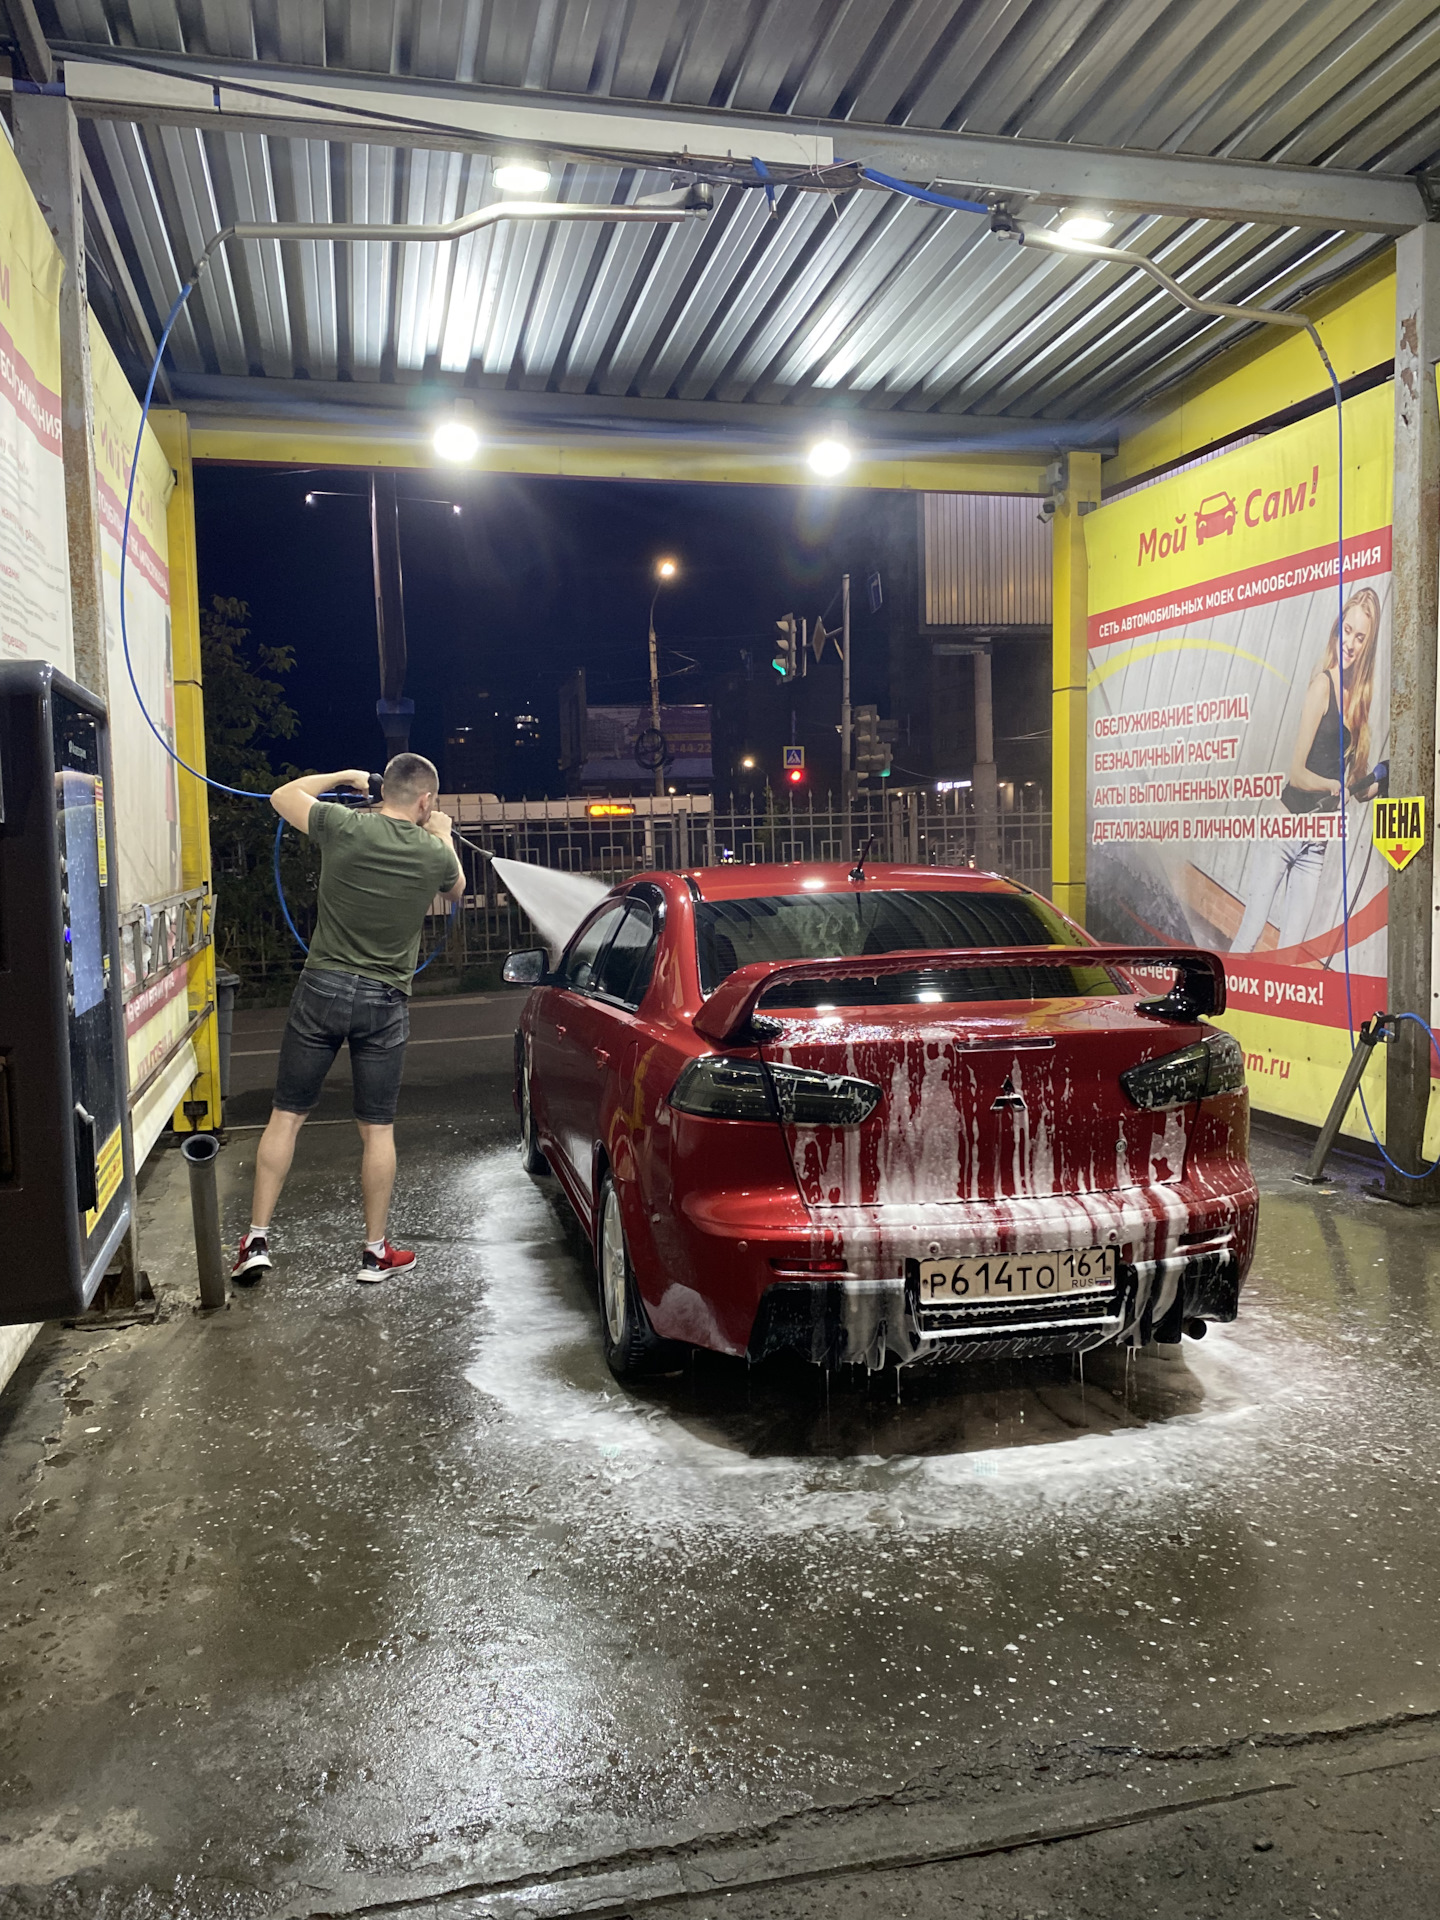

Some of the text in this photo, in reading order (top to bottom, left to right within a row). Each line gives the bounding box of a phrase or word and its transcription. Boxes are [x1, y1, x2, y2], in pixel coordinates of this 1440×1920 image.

[1137, 464, 1319, 567] Мой Сам!
[1098, 545, 1381, 638] СЕТЬ АВТОМОБИЛЬНЫХ МОЕК САМООБСЛУЖИВАНИЯ
[1095, 696, 1249, 737] ОБСЛУЖИВАНИЕ ЮРЛИЦ
[1095, 738, 1238, 771] БЕЗНАЛИЧНЫЙ РАСЧЕТ
[1094, 776, 1282, 805] АКТЫ ВЫПОЛНЕННЫХ РАБОТ
[1094, 815, 1347, 843] ДЕТАЛИЗАЦИЯ В ЛИЧНОМ КАБИНЕТЕ
[1376, 801, 1421, 838] ПЕНА
[1130, 966, 1178, 981] ачест
[1264, 980, 1324, 1005] руках!
[930, 1252, 1107, 1298] Р614ТО 161
[1071, 1277, 1094, 1288] RUS
